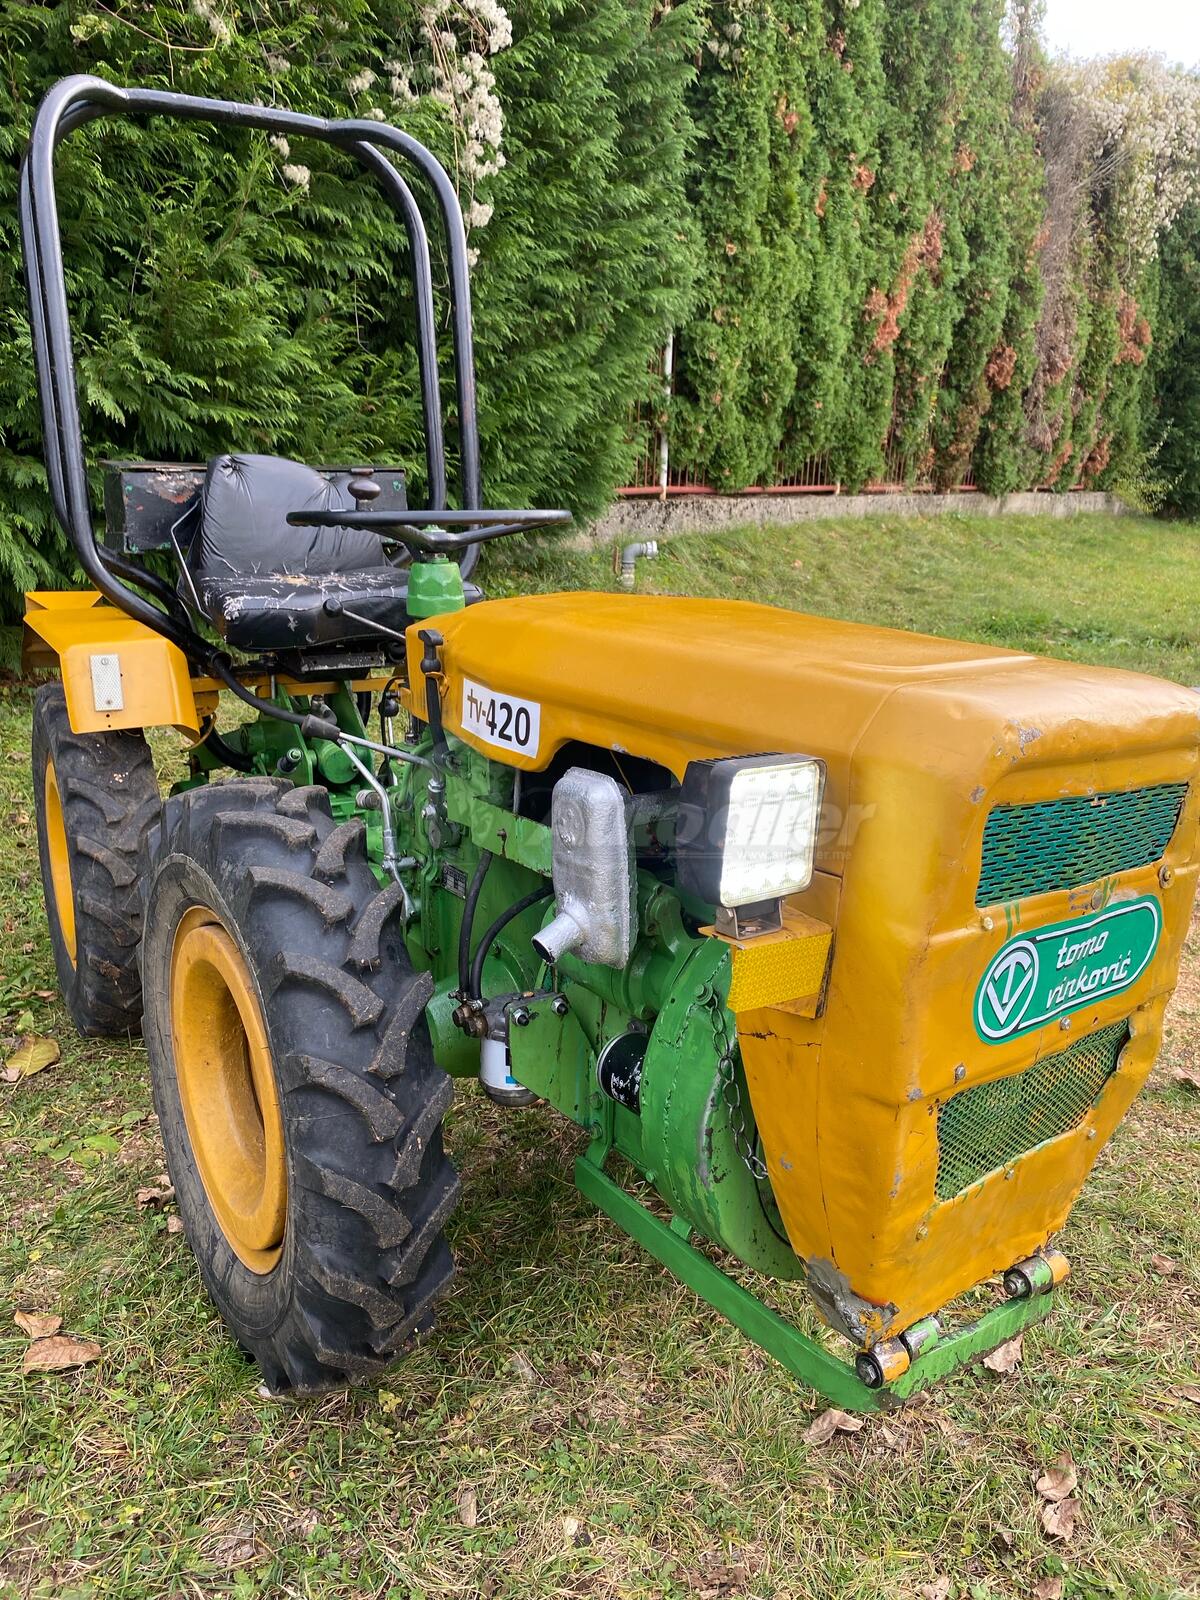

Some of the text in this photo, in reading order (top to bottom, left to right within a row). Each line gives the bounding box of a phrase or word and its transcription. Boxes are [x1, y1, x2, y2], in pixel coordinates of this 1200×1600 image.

[466, 688, 531, 746] tv-420
[1046, 950, 1131, 1009] vinković
[1056, 931, 1109, 970] tomo
